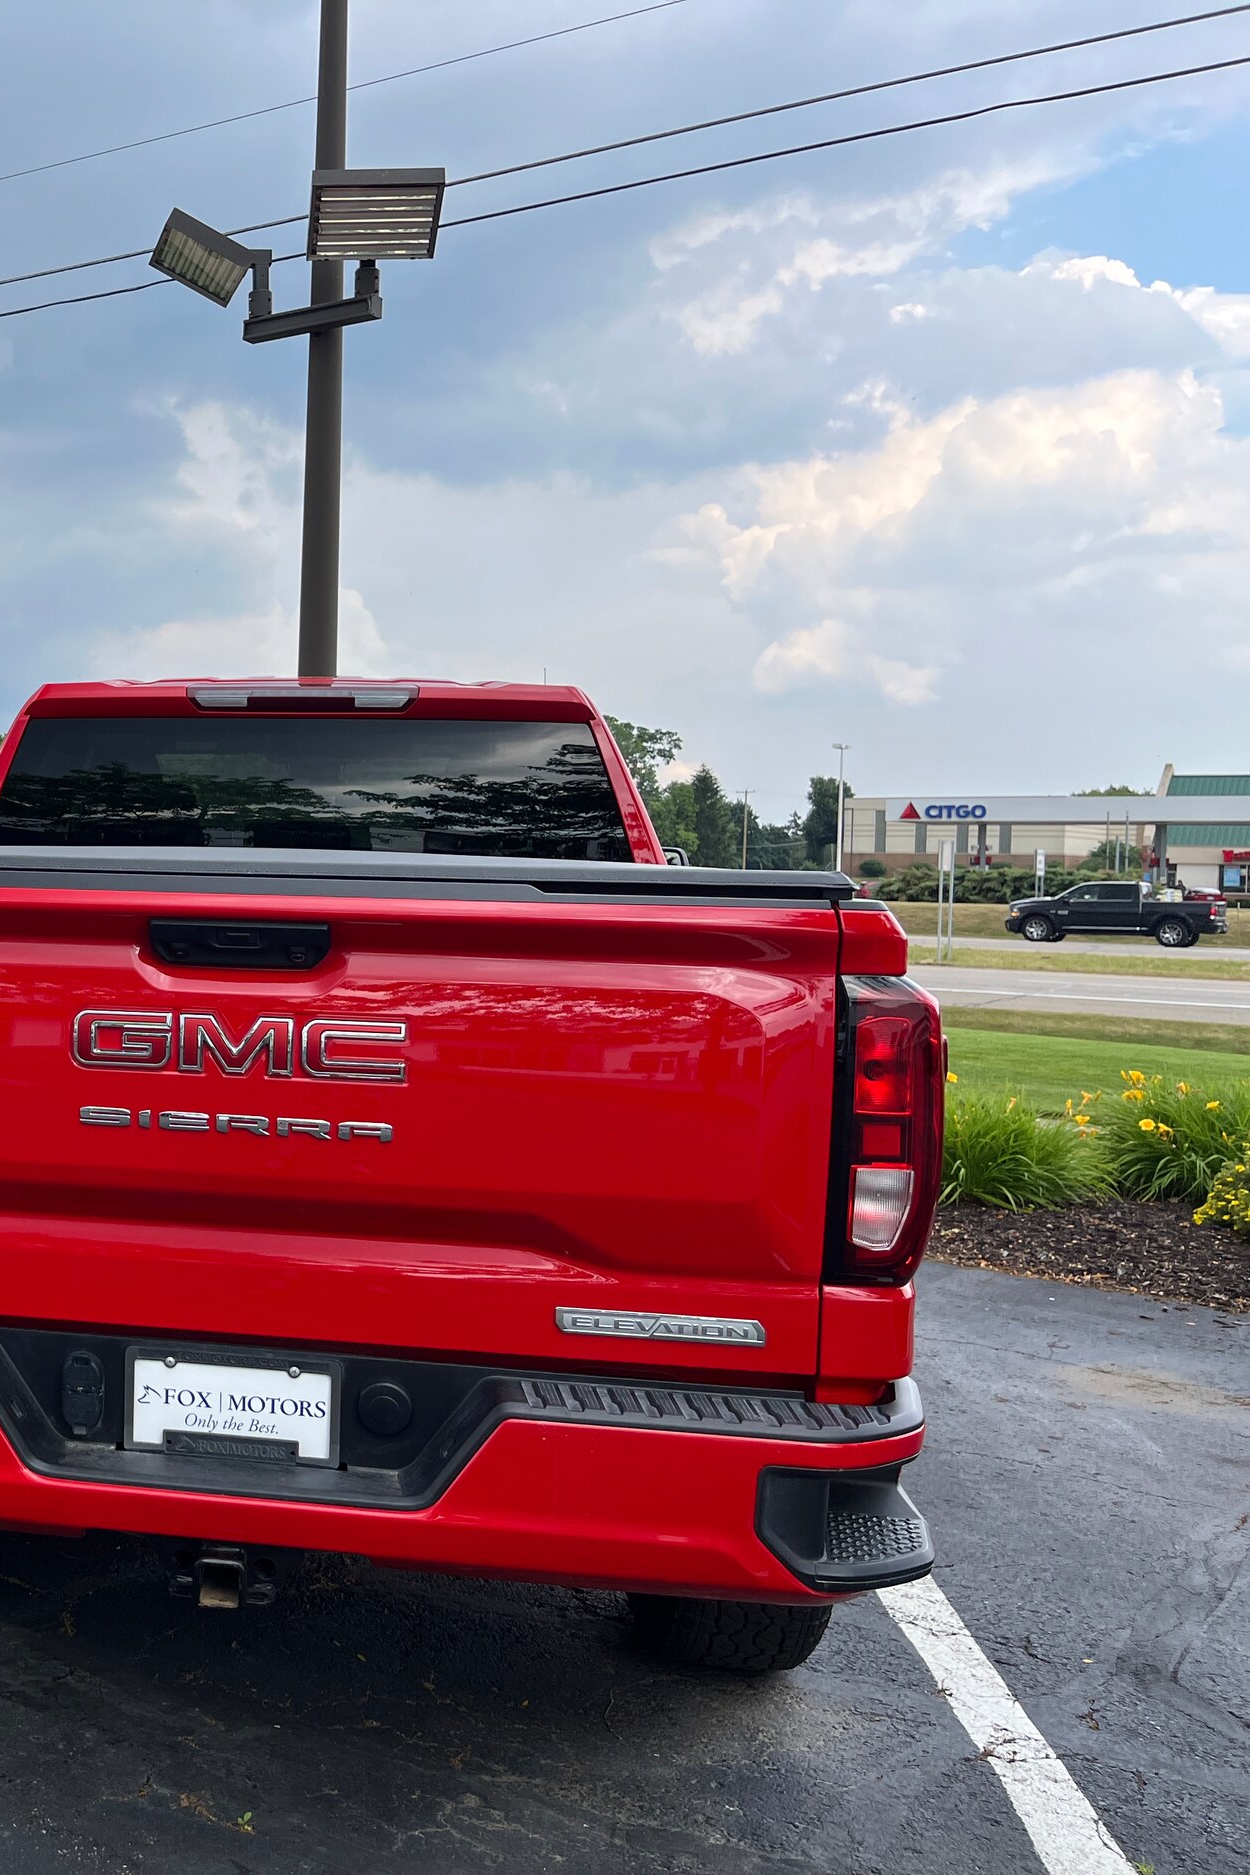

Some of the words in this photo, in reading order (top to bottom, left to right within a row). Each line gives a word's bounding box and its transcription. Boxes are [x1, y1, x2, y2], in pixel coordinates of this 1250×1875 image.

[924, 804, 987, 819] CITGO
[71, 1008, 408, 1084] GMC
[79, 1105, 393, 1143] SIERRA
[570, 1315, 750, 1339] ELEVATION
[163, 1387, 212, 1409] FOX
[228, 1394, 326, 1419] MOTORS
[184, 1412, 219, 1433] Only
[223, 1416, 244, 1432] the
[248, 1419, 279, 1435] Best.
